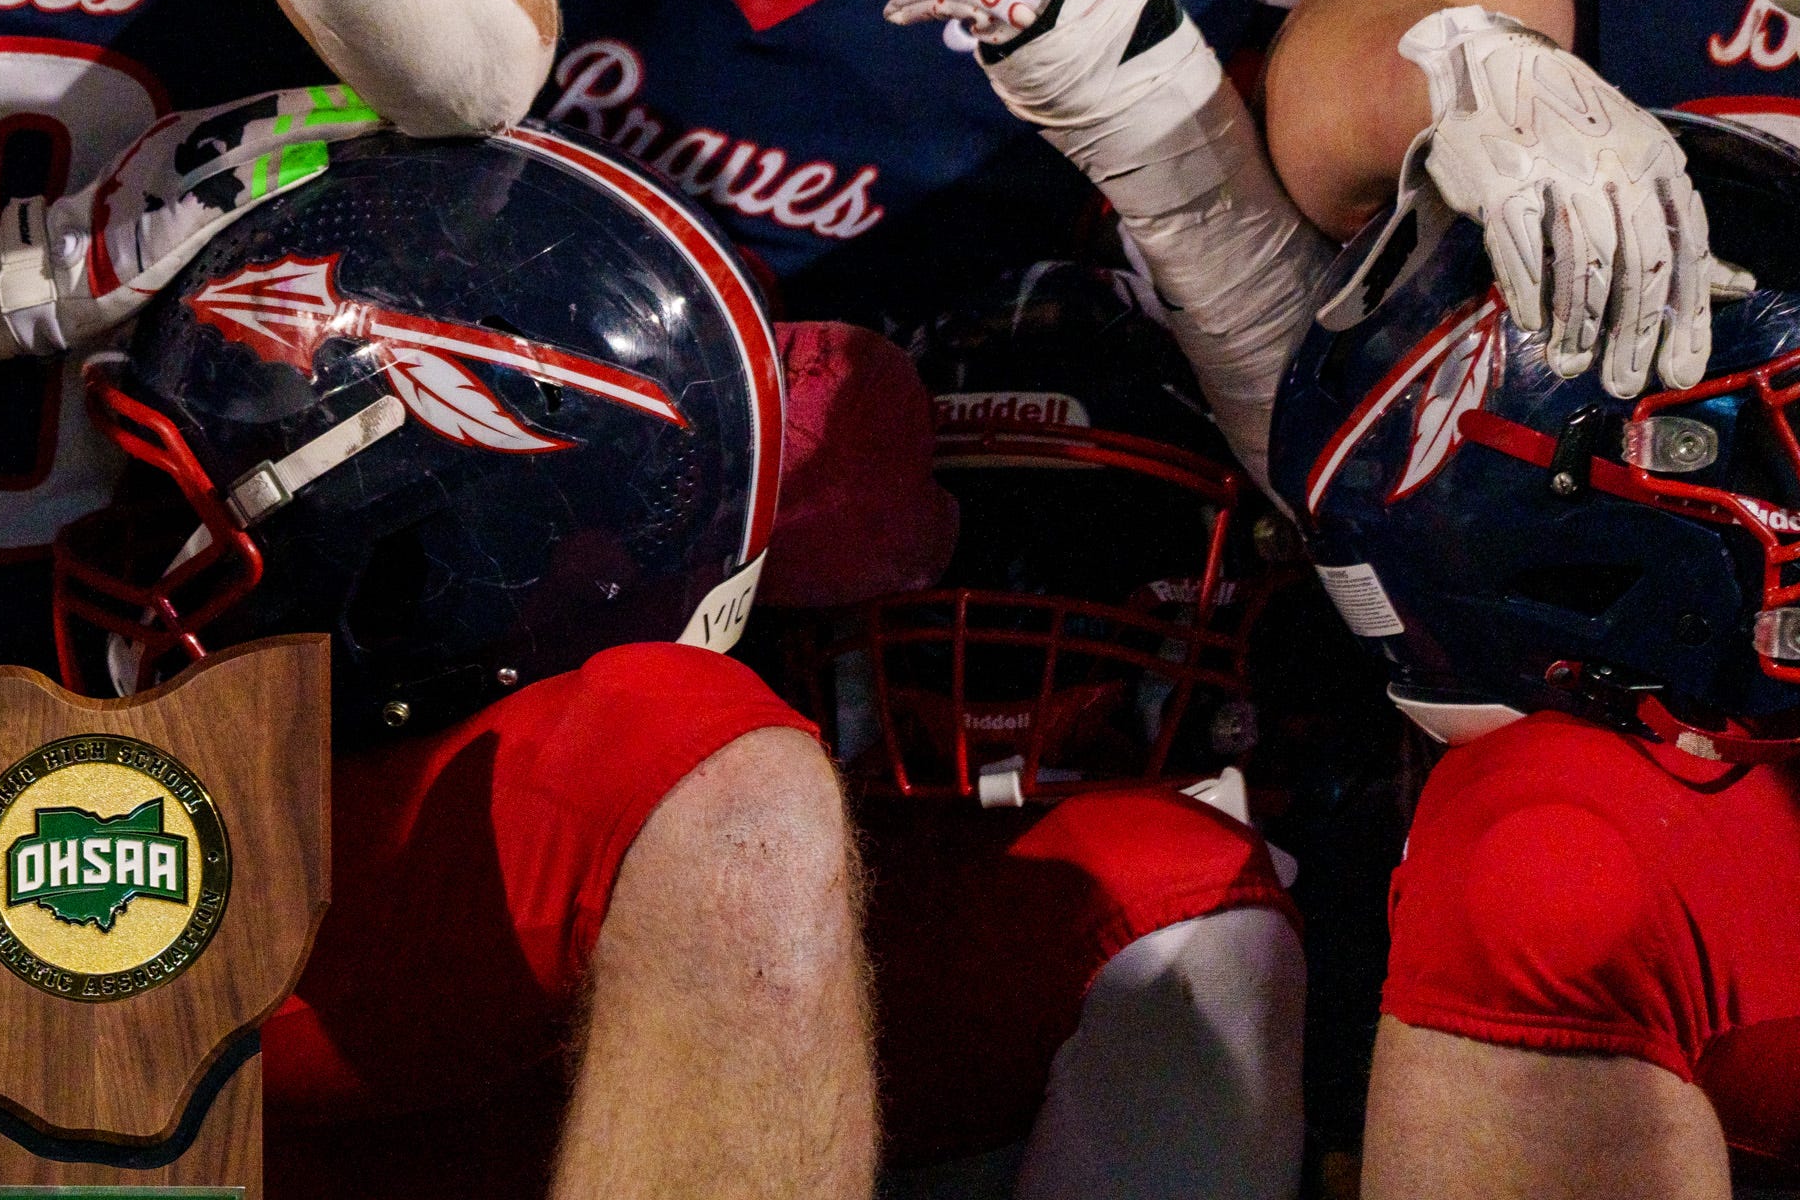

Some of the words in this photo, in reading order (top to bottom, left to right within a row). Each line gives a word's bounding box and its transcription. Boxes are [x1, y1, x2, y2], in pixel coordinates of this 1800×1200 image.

[43, 742, 108, 772] HIGH
[116, 744, 206, 816] SCHOOL
[16, 837, 178, 894] OHSAA
[81, 888, 221, 997] ASSOCIATION
